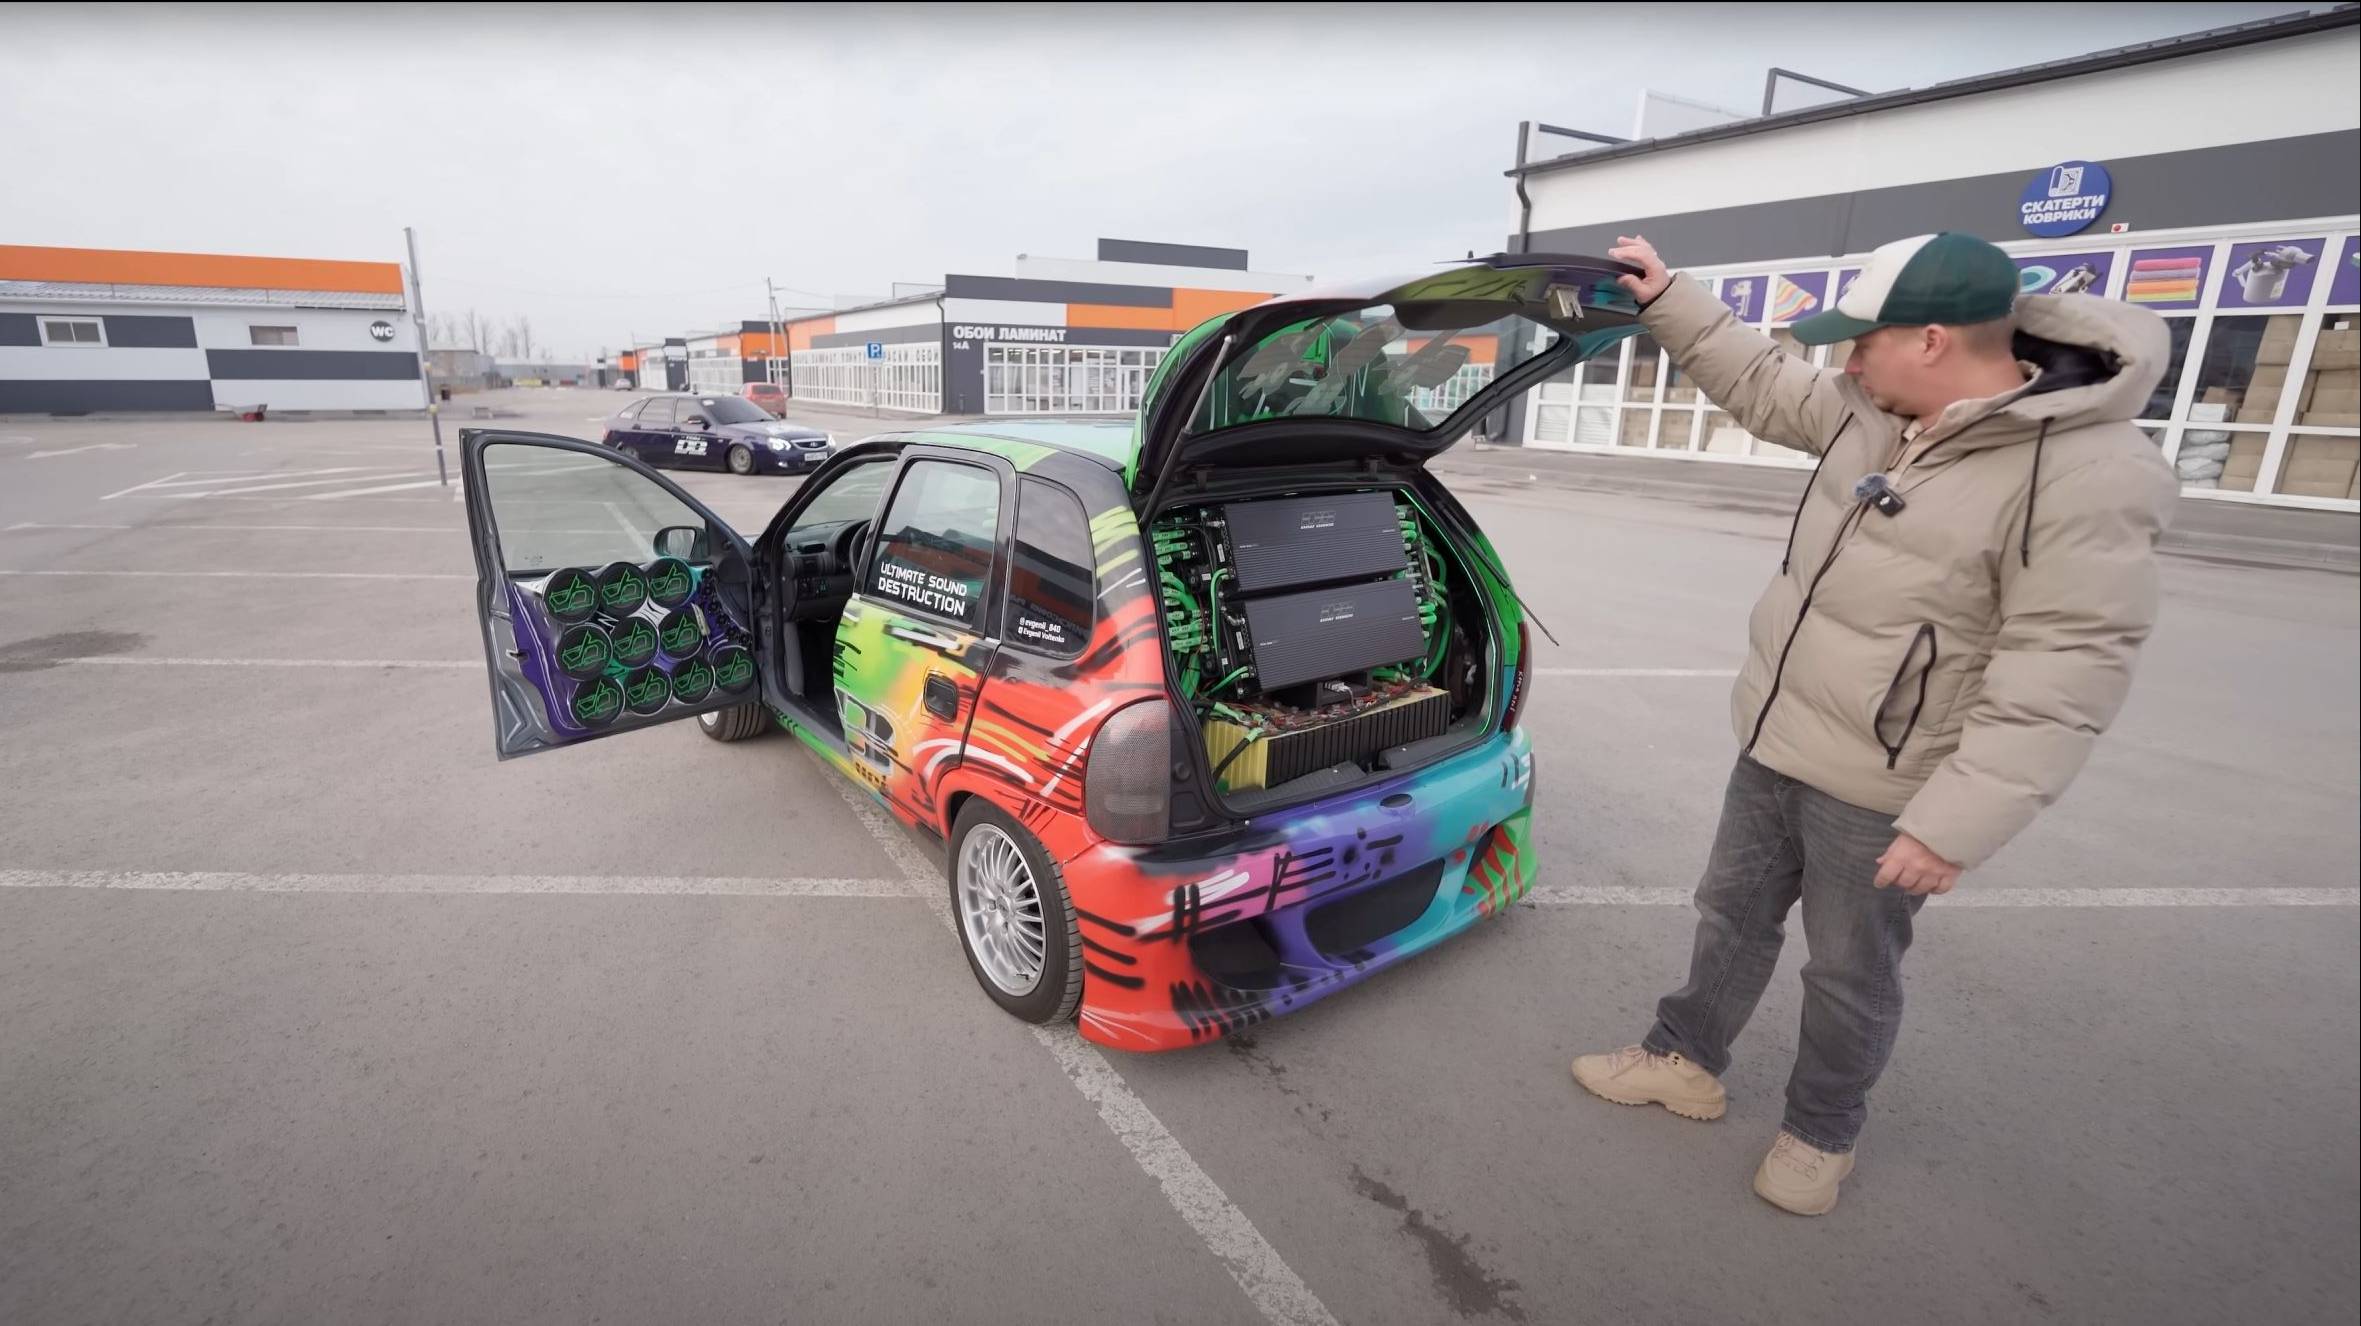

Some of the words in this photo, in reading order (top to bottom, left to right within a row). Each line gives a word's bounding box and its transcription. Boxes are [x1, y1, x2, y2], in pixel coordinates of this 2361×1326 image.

[2021, 194, 2105, 213] СКАТЕРТИ
[2023, 208, 2097, 225] КОВРИКИ
[371, 326, 394, 337] WC
[953, 325, 995, 340] ОБОИ
[998, 327, 1067, 342] ЛАМИНАТ
[870, 344, 880, 358] P
[880, 561, 926, 584] ULTIMATE
[928, 575, 967, 597] SOUND
[878, 577, 966, 616] DESTRUCTION
